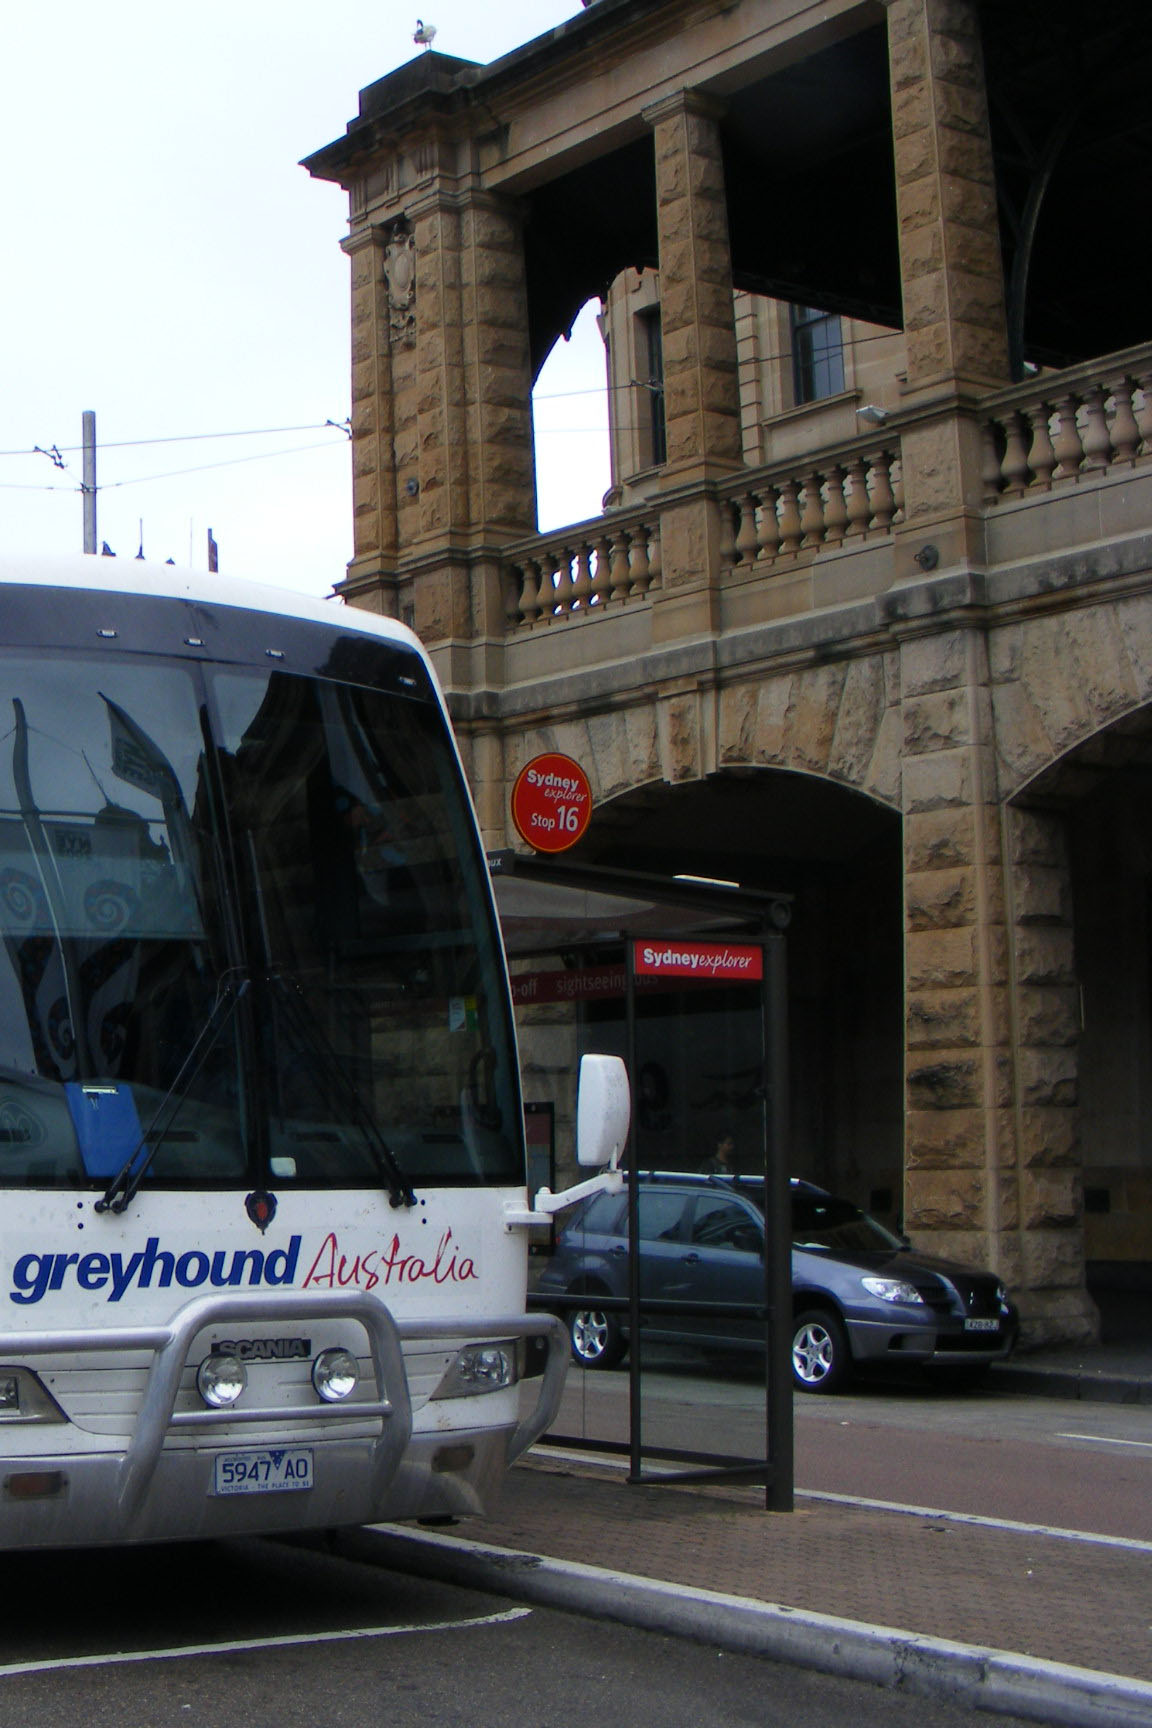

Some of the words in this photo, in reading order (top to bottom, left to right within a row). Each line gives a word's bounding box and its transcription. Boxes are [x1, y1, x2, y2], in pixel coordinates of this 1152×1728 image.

[527, 769, 579, 792] Sydney
[544, 788, 587, 804] explorer
[531, 812, 555, 831] Stop
[557, 805, 579, 832] 16
[9, 1235, 302, 1305] greyhound
[302, 1226, 479, 1290] Australia
[219, 1338, 305, 1360] SCANIA
[222, 1461, 271, 1484] 5947
